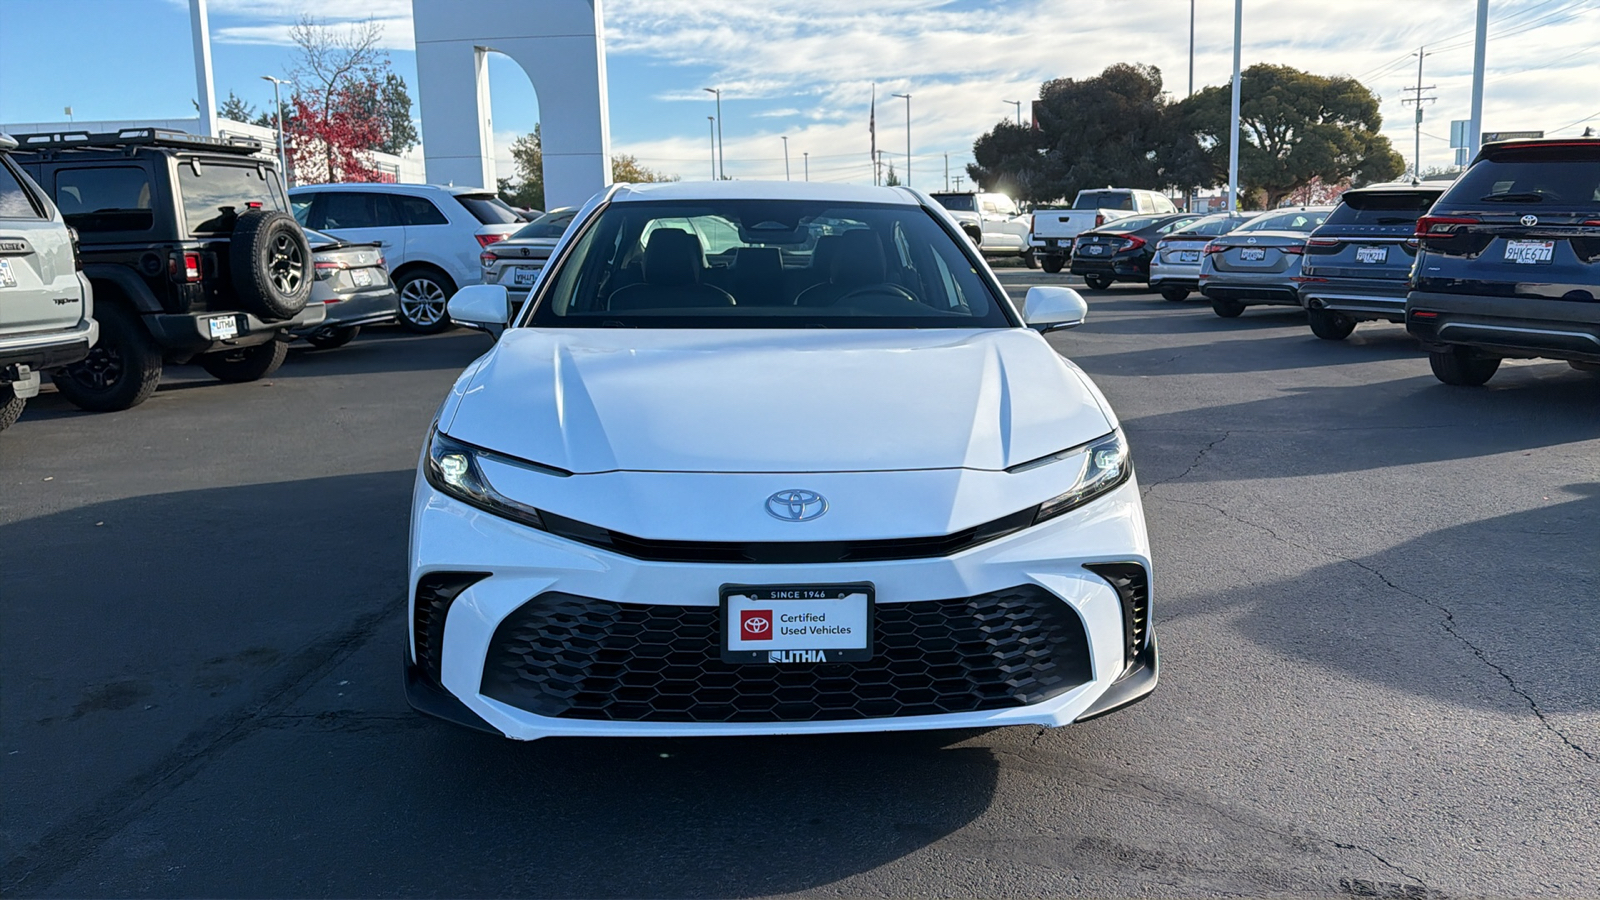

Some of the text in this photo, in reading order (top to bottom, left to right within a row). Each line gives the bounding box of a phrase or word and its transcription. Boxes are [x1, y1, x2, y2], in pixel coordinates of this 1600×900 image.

[1507, 247, 1551, 261] 9HKE677
[771, 590, 826, 599] SINCE 1946
[780, 612, 826, 623] Certified
[780, 625, 852, 635] Used Vehicles
[781, 650, 827, 663] LITHIA
